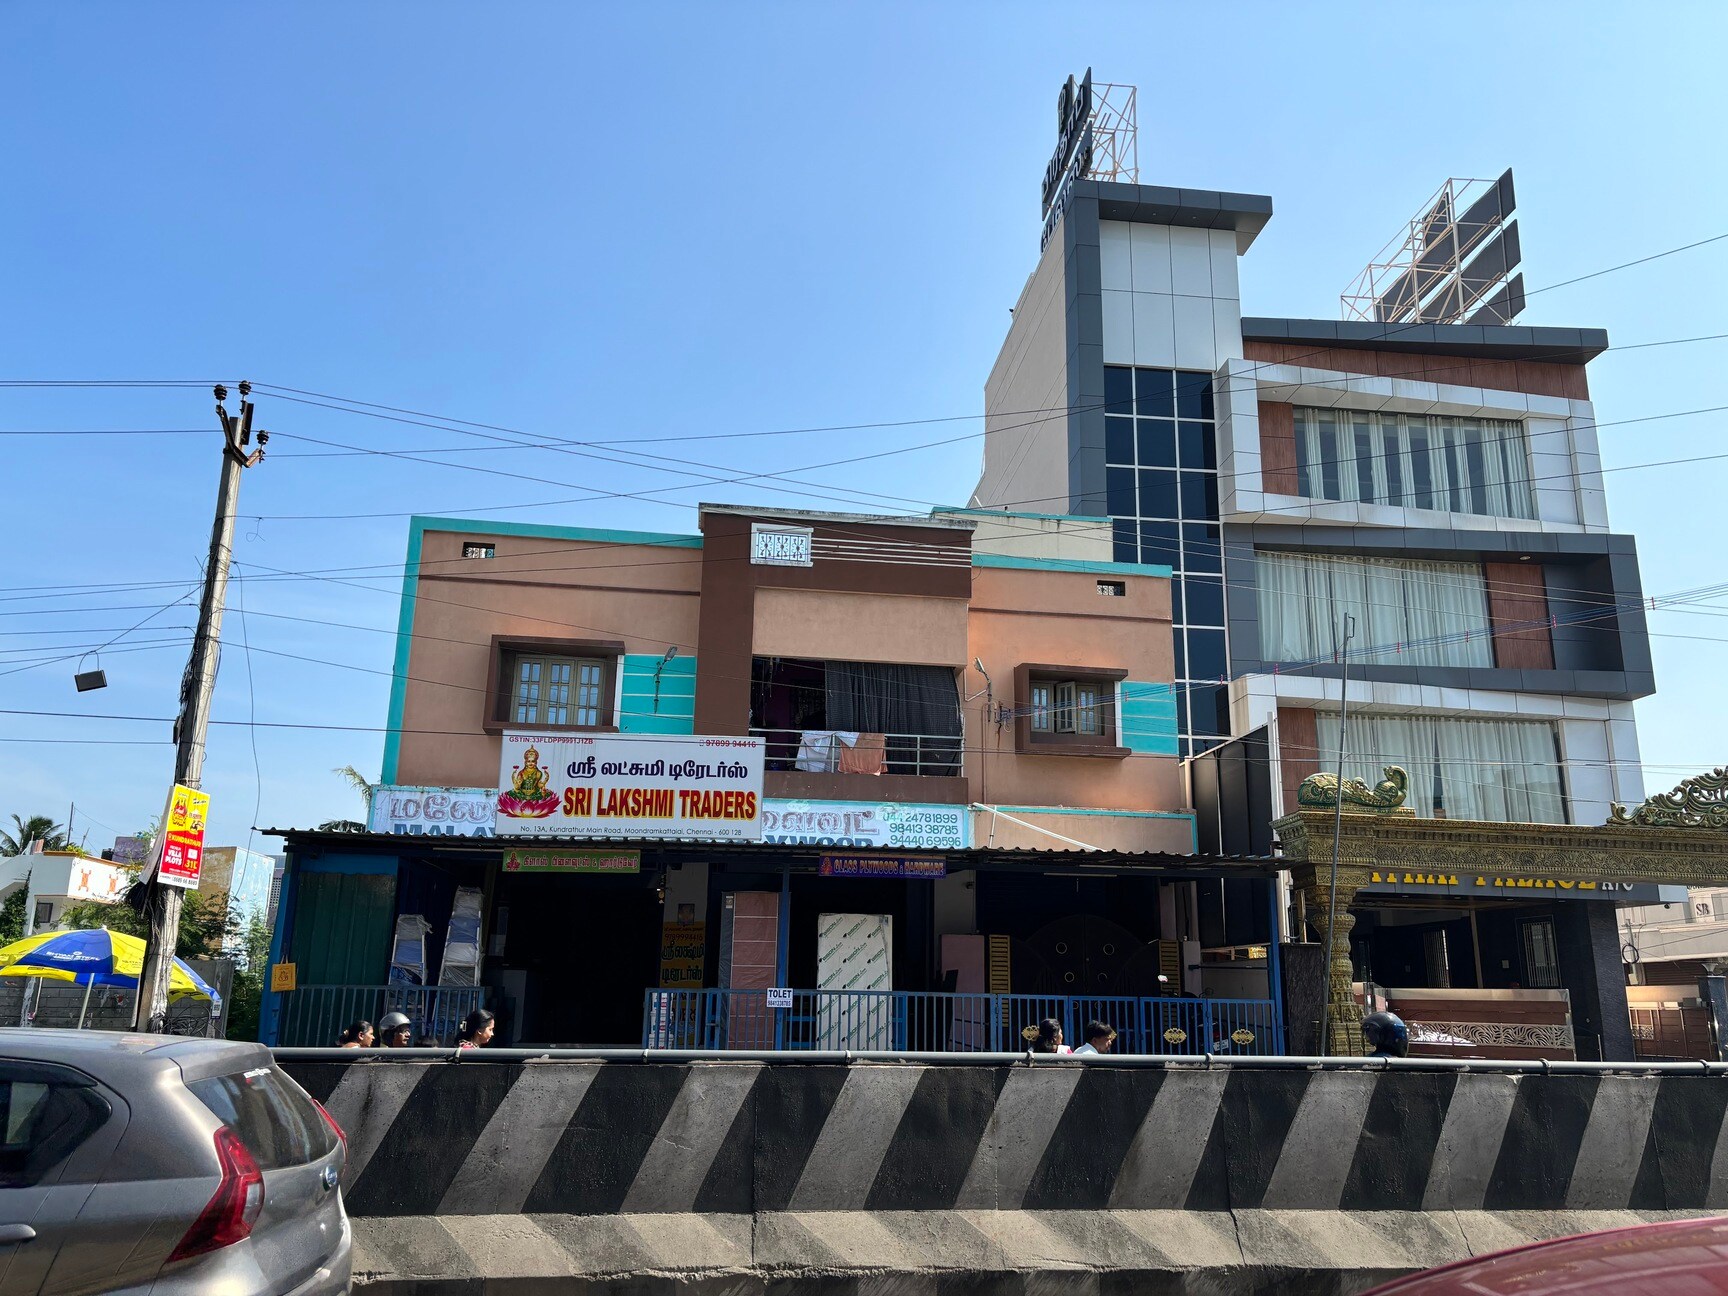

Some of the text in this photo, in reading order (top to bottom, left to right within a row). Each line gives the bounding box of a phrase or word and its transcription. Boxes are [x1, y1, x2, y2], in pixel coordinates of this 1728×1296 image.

[567, 755, 748, 780] ஸ்ரீ லட்சுமி டிரேடர்ஸ்
[563, 786, 757, 820] SRI LAKSHMI TRADERS
[905, 812, 958, 824] 24781899
[520, 825, 532, 833] No.
[549, 825, 585, 834] Kundrathur
[586, 826, 602, 834] Main
[603, 826, 623, 835] Road,
[686, 828, 714, 836] Chennai
[889, 822, 959, 835] 98413 38785
[890, 834, 962, 847] 94440 69596
[165, 855, 182, 866] PLOTS
[833, 858, 858, 873] GLASS
[859, 859, 899, 875] PLYWOODS
[904, 861, 944, 876] HARDWARE
[768, 989, 792, 998] TOLET
